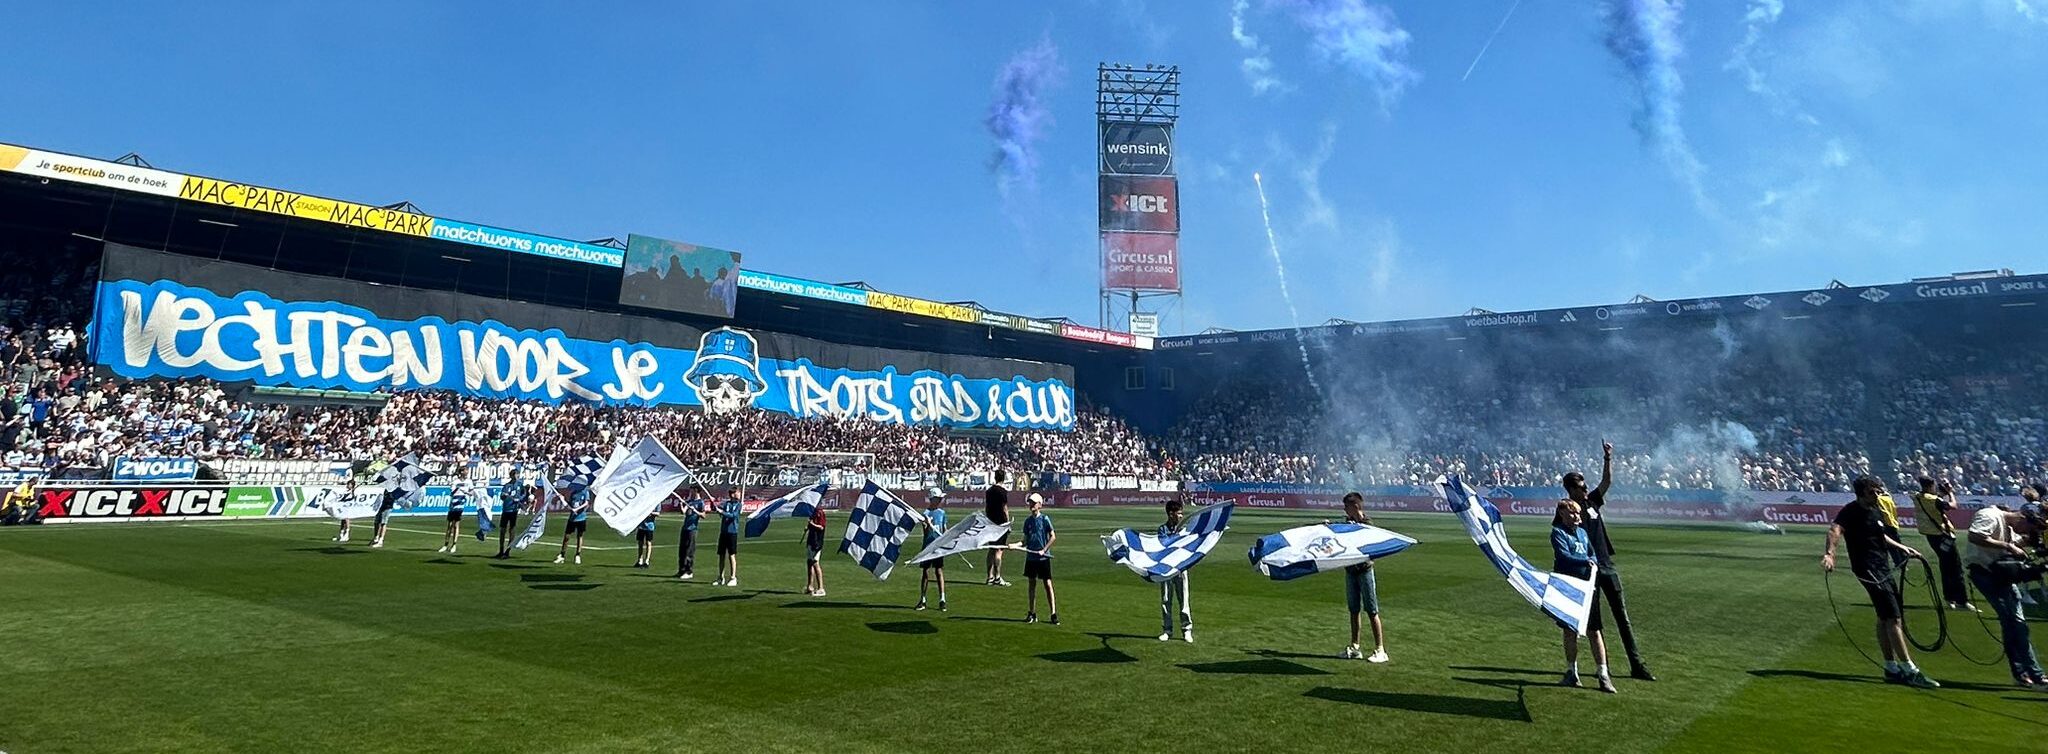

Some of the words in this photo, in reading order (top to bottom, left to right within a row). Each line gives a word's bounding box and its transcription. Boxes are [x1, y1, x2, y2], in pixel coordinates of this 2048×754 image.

[1107, 142, 1168, 155] wensink
[36, 160, 51, 169] Je
[52, 163, 106, 179] sportclub
[108, 172, 125, 181] om
[127, 175, 141, 184] de
[142, 176, 169, 188] hoek
[296, 200, 332, 213] STADION
[433, 224, 532, 250] matchworks
[535, 241, 623, 265] matchworks
[1108, 249, 1173, 265] Circus.nl
[1109, 265, 1134, 273] SPORT
[1136, 265, 1143, 273] &
[1144, 265, 1174, 273] CASINO
[738, 275, 804, 294] matchworks
[805, 286, 866, 303] matchworks
[1916, 281, 1989, 298] Circus.nl
[2001, 281, 2034, 291] SPORT
[1465, 312, 1538, 327] voetbalshop.nl
[1160, 338, 1193, 348] Circus.nl
[459, 328, 603, 401] VOOR
[910, 376, 982, 422] STAD
[988, 385, 1005, 422] &
[1006, 382, 1073, 428] CLUB
[119, 460, 194, 476] ZWOLLE
[689, 468, 727, 486] East
[1248, 495, 1285, 507] Circus.nl
[1511, 501, 1556, 513] Circus.n
[1763, 506, 1828, 525] Circus.nl
